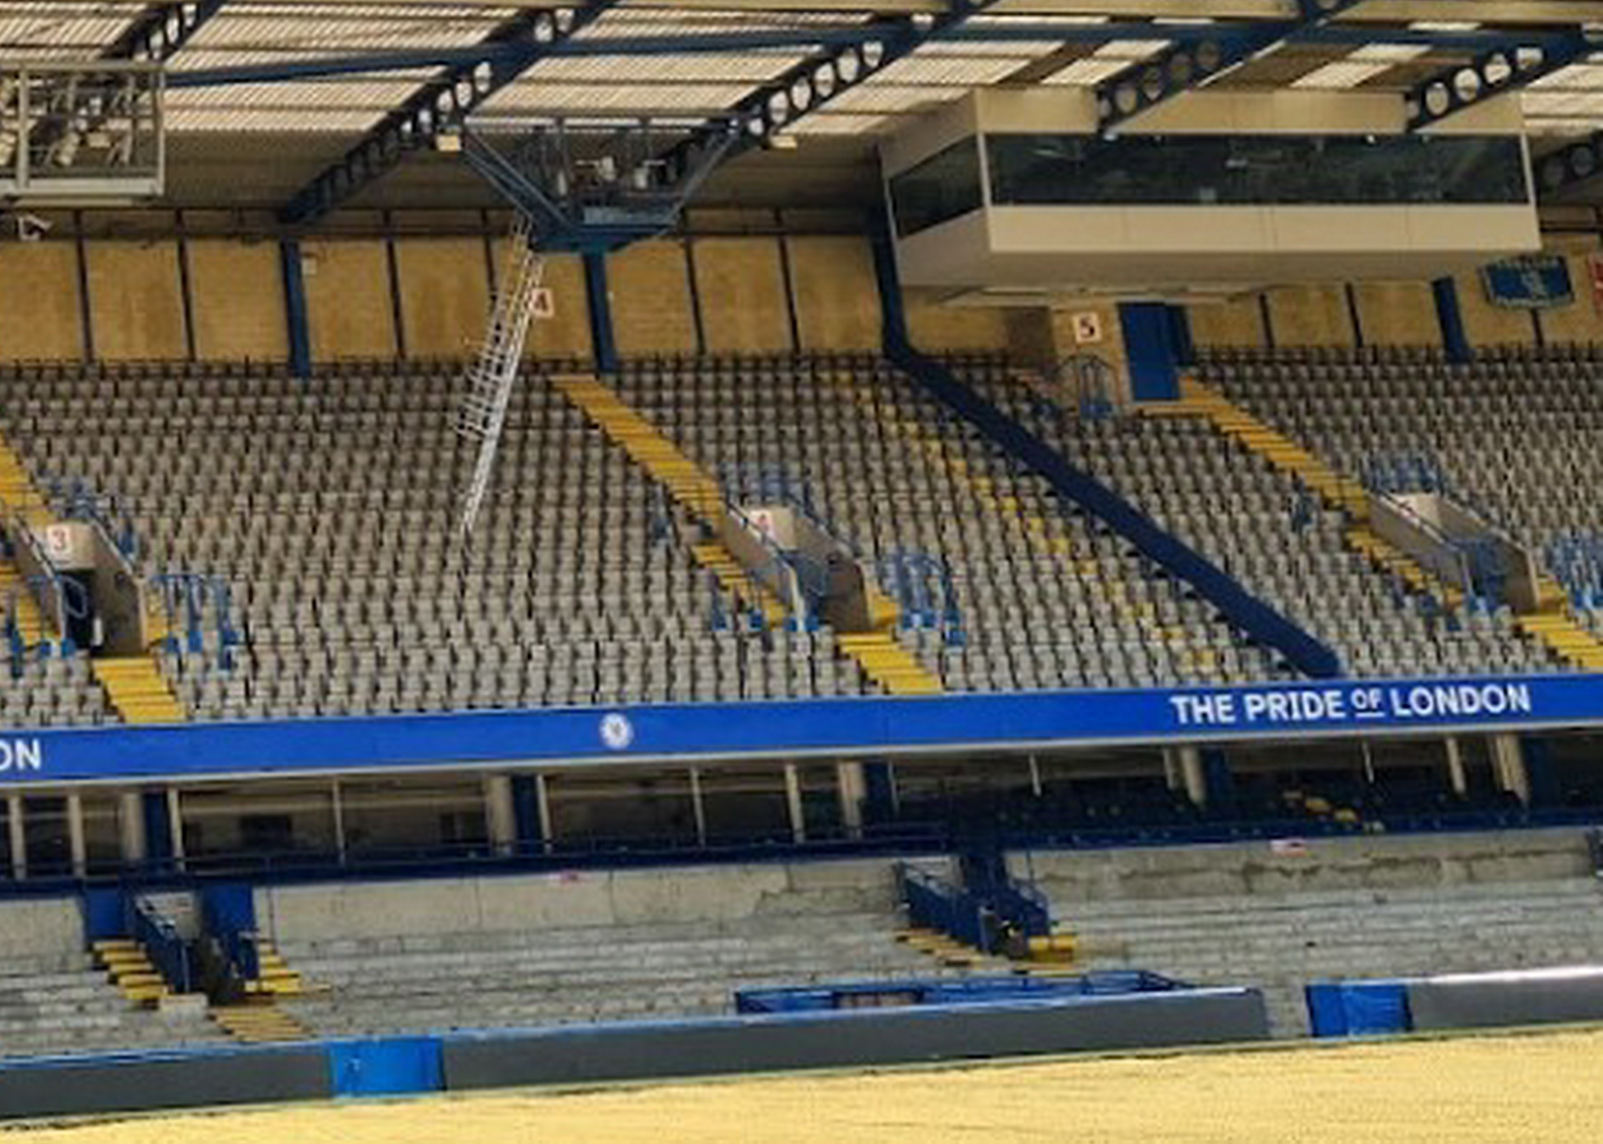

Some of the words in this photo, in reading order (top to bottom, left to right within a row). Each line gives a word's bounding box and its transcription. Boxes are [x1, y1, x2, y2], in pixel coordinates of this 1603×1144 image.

[1079, 316, 1096, 338] 5
[1170, 695, 1237, 725] THE
[1245, 690, 1346, 721] PRIDE
[1350, 688, 1384, 717] OF
[1393, 683, 1531, 717] LONDON
